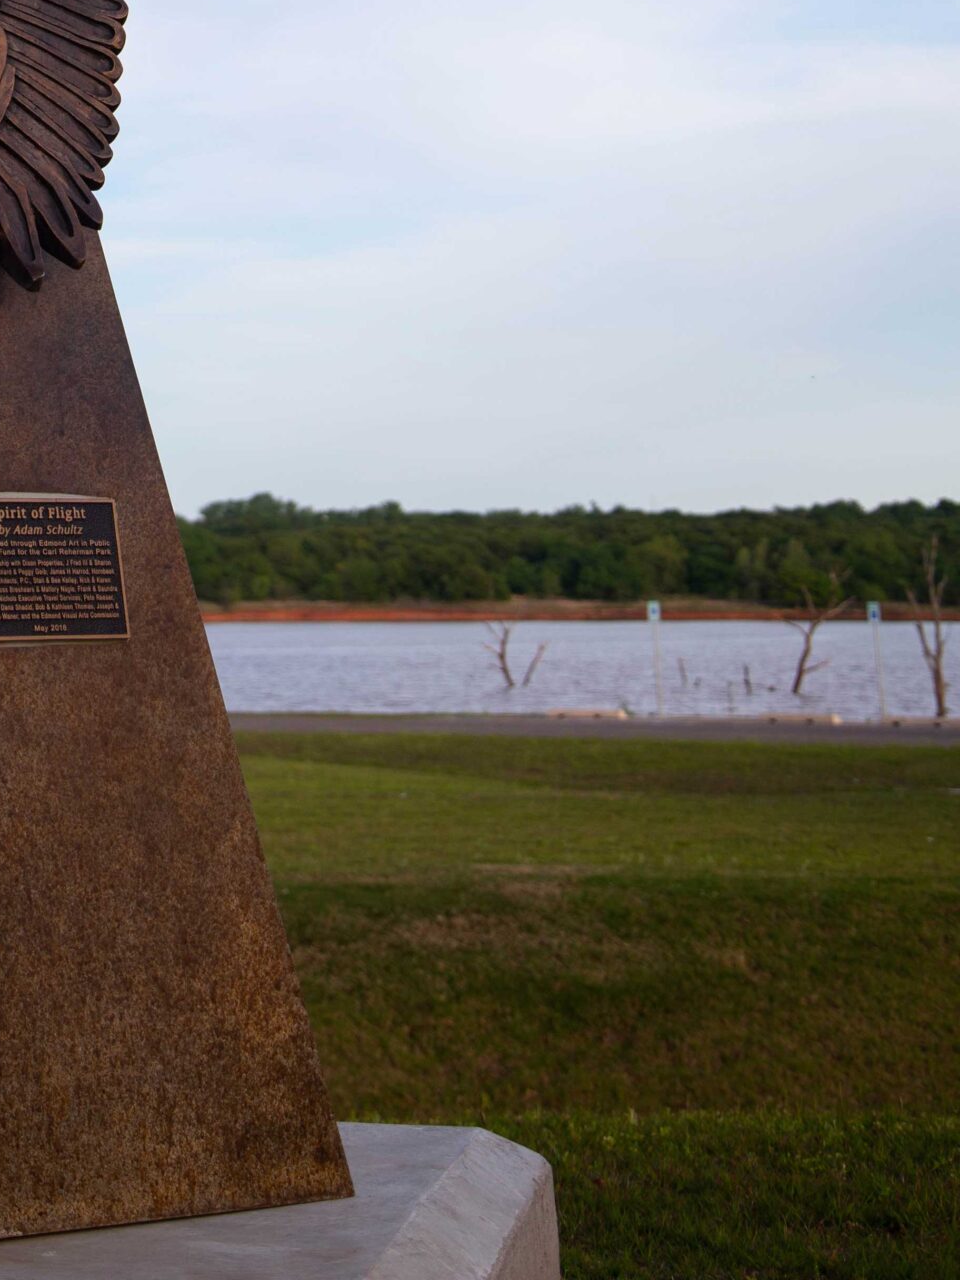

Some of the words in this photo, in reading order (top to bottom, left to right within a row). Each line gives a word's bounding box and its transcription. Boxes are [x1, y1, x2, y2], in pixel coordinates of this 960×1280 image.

[31, 506, 44, 518] of
[48, 506, 86, 522] Flight
[14, 524, 42, 534] Adam
[46, 524, 84, 534] Schultz
[34, 624, 48, 632] May
